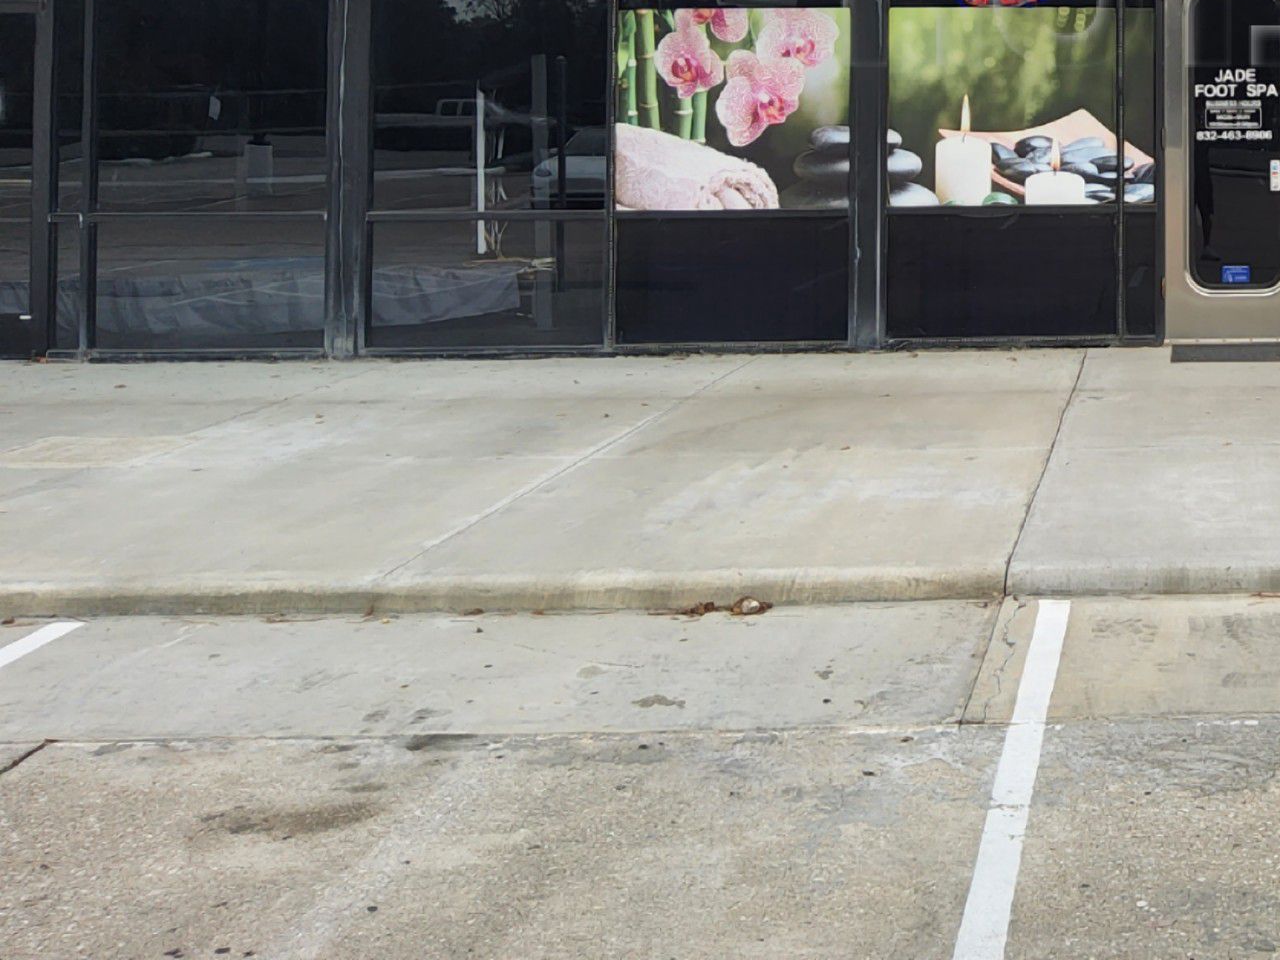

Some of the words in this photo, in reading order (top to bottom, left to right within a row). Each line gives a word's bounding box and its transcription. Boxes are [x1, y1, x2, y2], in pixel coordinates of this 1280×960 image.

[1214, 69, 1256, 82] JADE
[1194, 83, 1237, 97] FOOT
[1246, 84, 1278, 97] SPA
